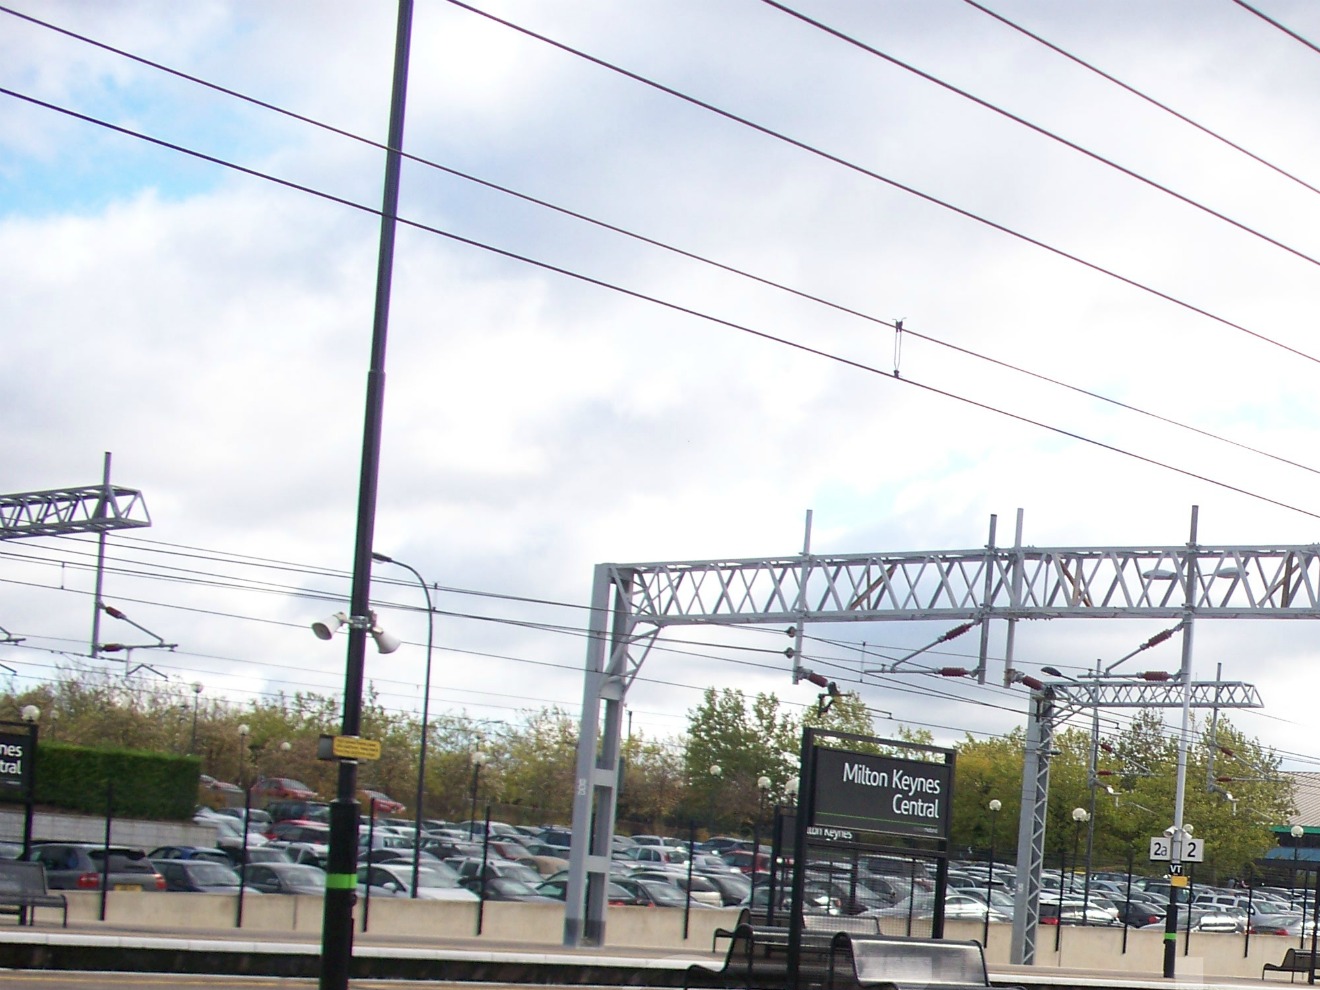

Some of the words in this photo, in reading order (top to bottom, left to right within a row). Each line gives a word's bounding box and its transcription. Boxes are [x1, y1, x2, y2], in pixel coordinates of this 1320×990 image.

[843, 762, 888, 787] Milton
[892, 769, 940, 796] Keynes
[892, 794, 940, 819] Central
[1154, 842, 1168, 856] 2a
[1187, 842, 1197, 858] 2
[1169, 864, 1182, 874] VT
